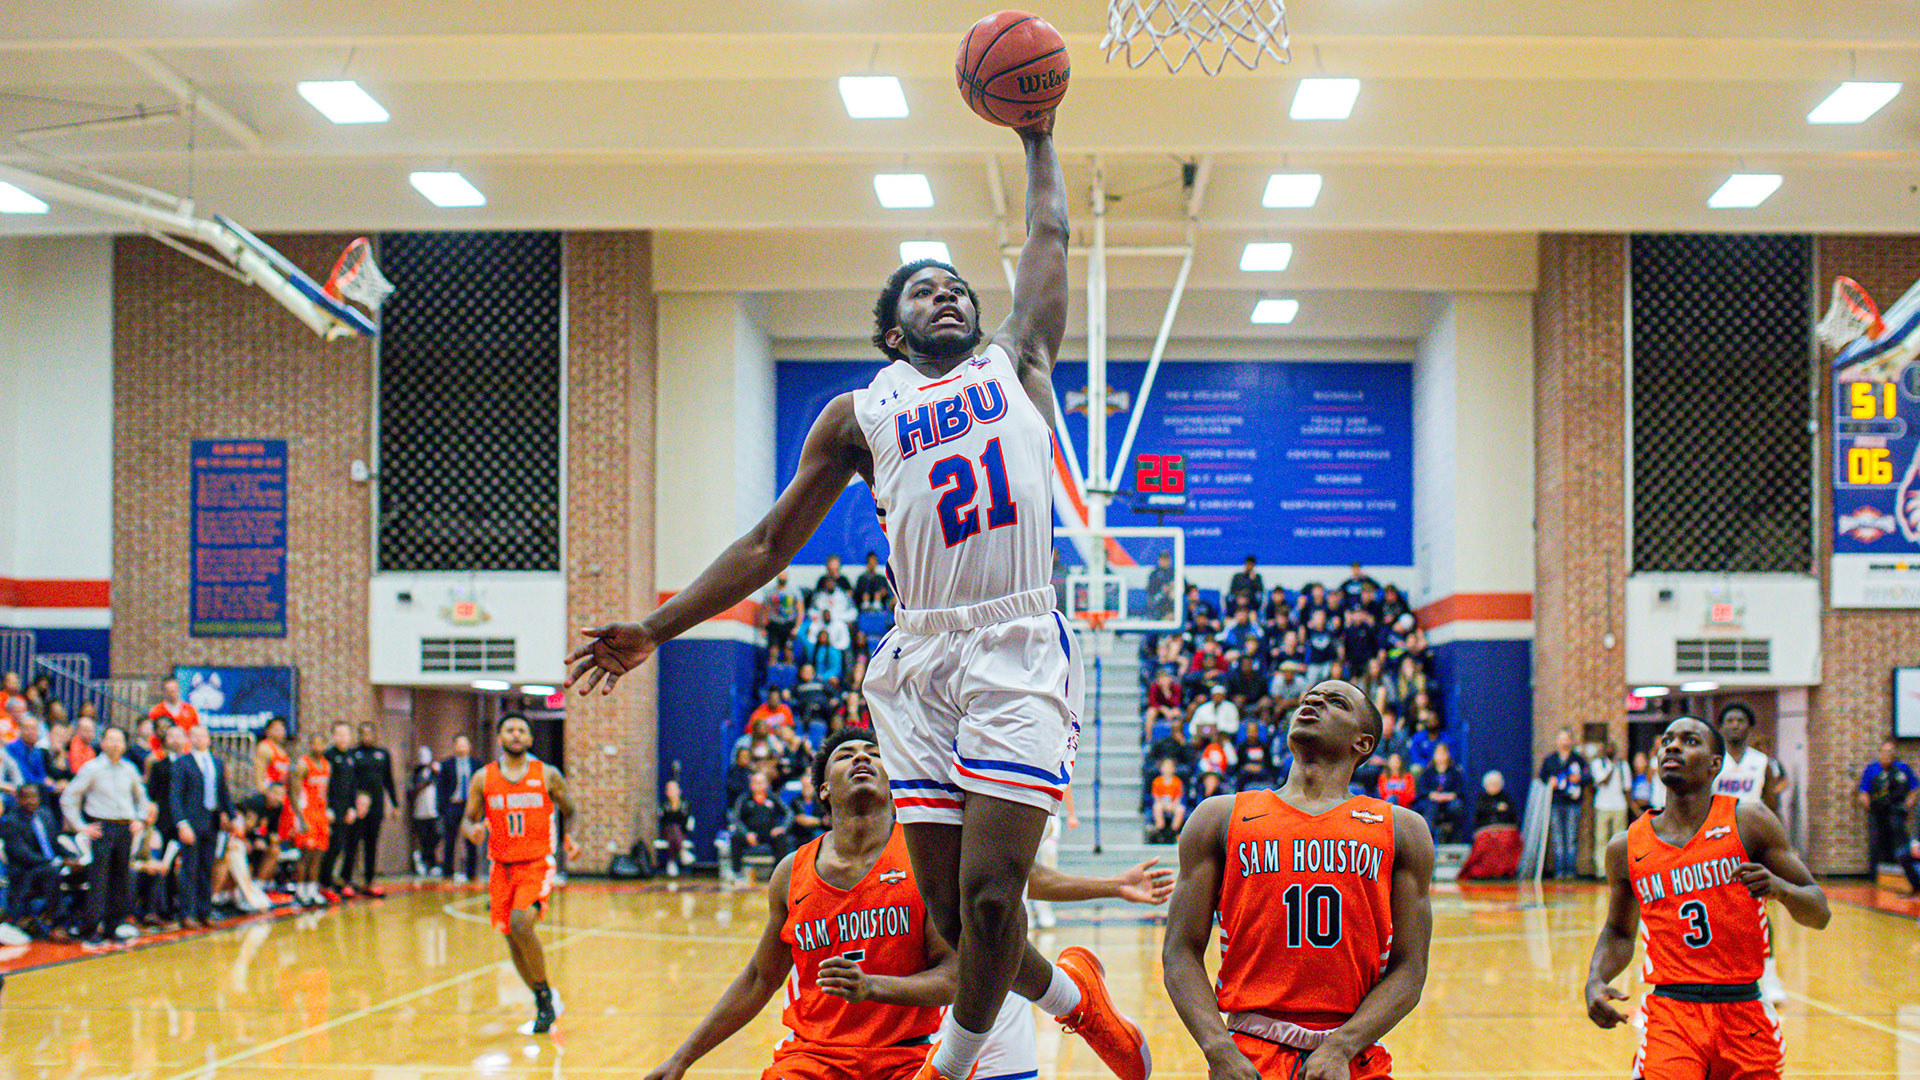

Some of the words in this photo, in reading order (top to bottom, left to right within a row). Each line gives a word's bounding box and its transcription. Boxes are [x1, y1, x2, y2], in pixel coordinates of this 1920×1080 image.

[1017, 68, 1070, 95] Wilso
[895, 378, 1008, 460] HBU
[1851, 382, 1897, 419] 51
[1136, 454, 1185, 493] 26
[1848, 448, 1893, 484] 06
[928, 436, 1018, 549] 21
[1717, 778, 1755, 793] HBU
[506, 811, 526, 837] 11
[1238, 839, 1281, 878] SAM
[1292, 838, 1385, 883] HOUSTON
[794, 917, 832, 951] SAM
[837, 905, 911, 943] HOUSTON
[1282, 883, 1343, 949] 10
[1678, 898, 1713, 950] 3
